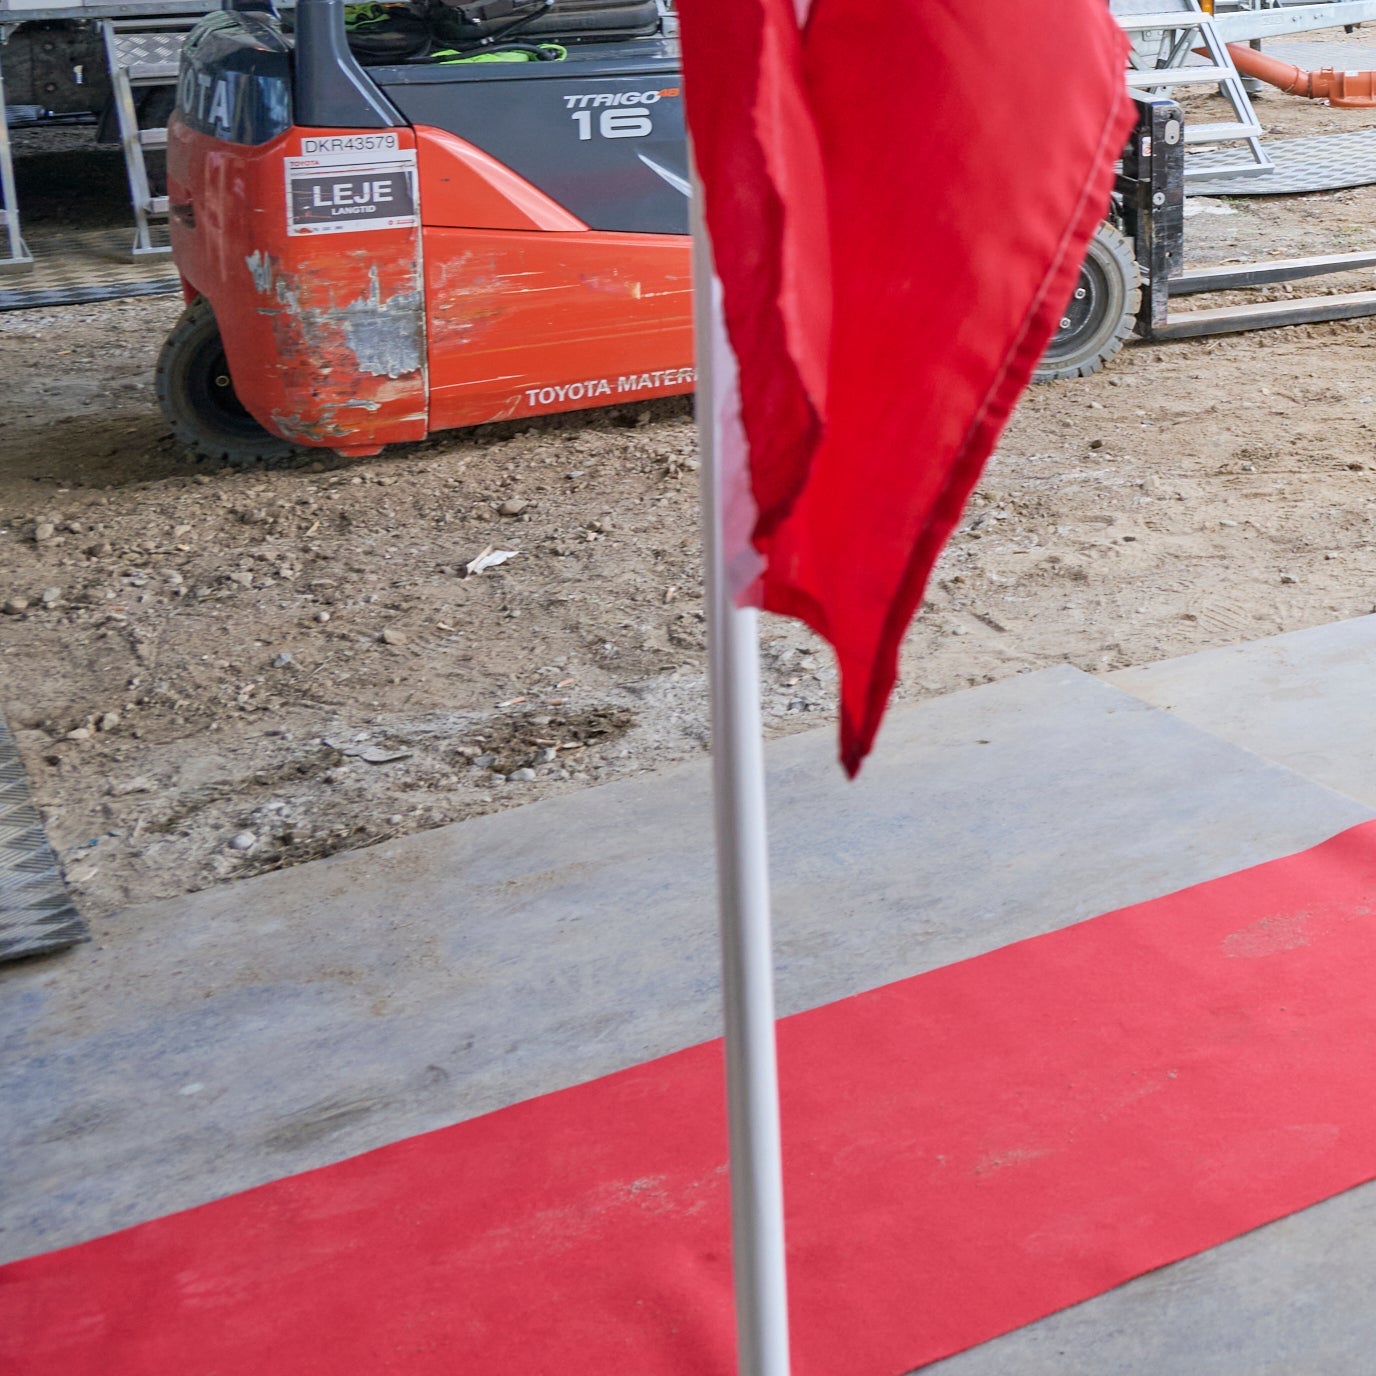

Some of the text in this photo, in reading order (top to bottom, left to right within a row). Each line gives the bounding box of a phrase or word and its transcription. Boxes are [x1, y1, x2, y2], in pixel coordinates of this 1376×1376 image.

[571, 107, 653, 140] 16
[305, 135, 395, 153] DKR43579
[312, 180, 393, 207] LEJE
[331, 205, 377, 215] LANGTID
[525, 379, 611, 406] TOYOTA
